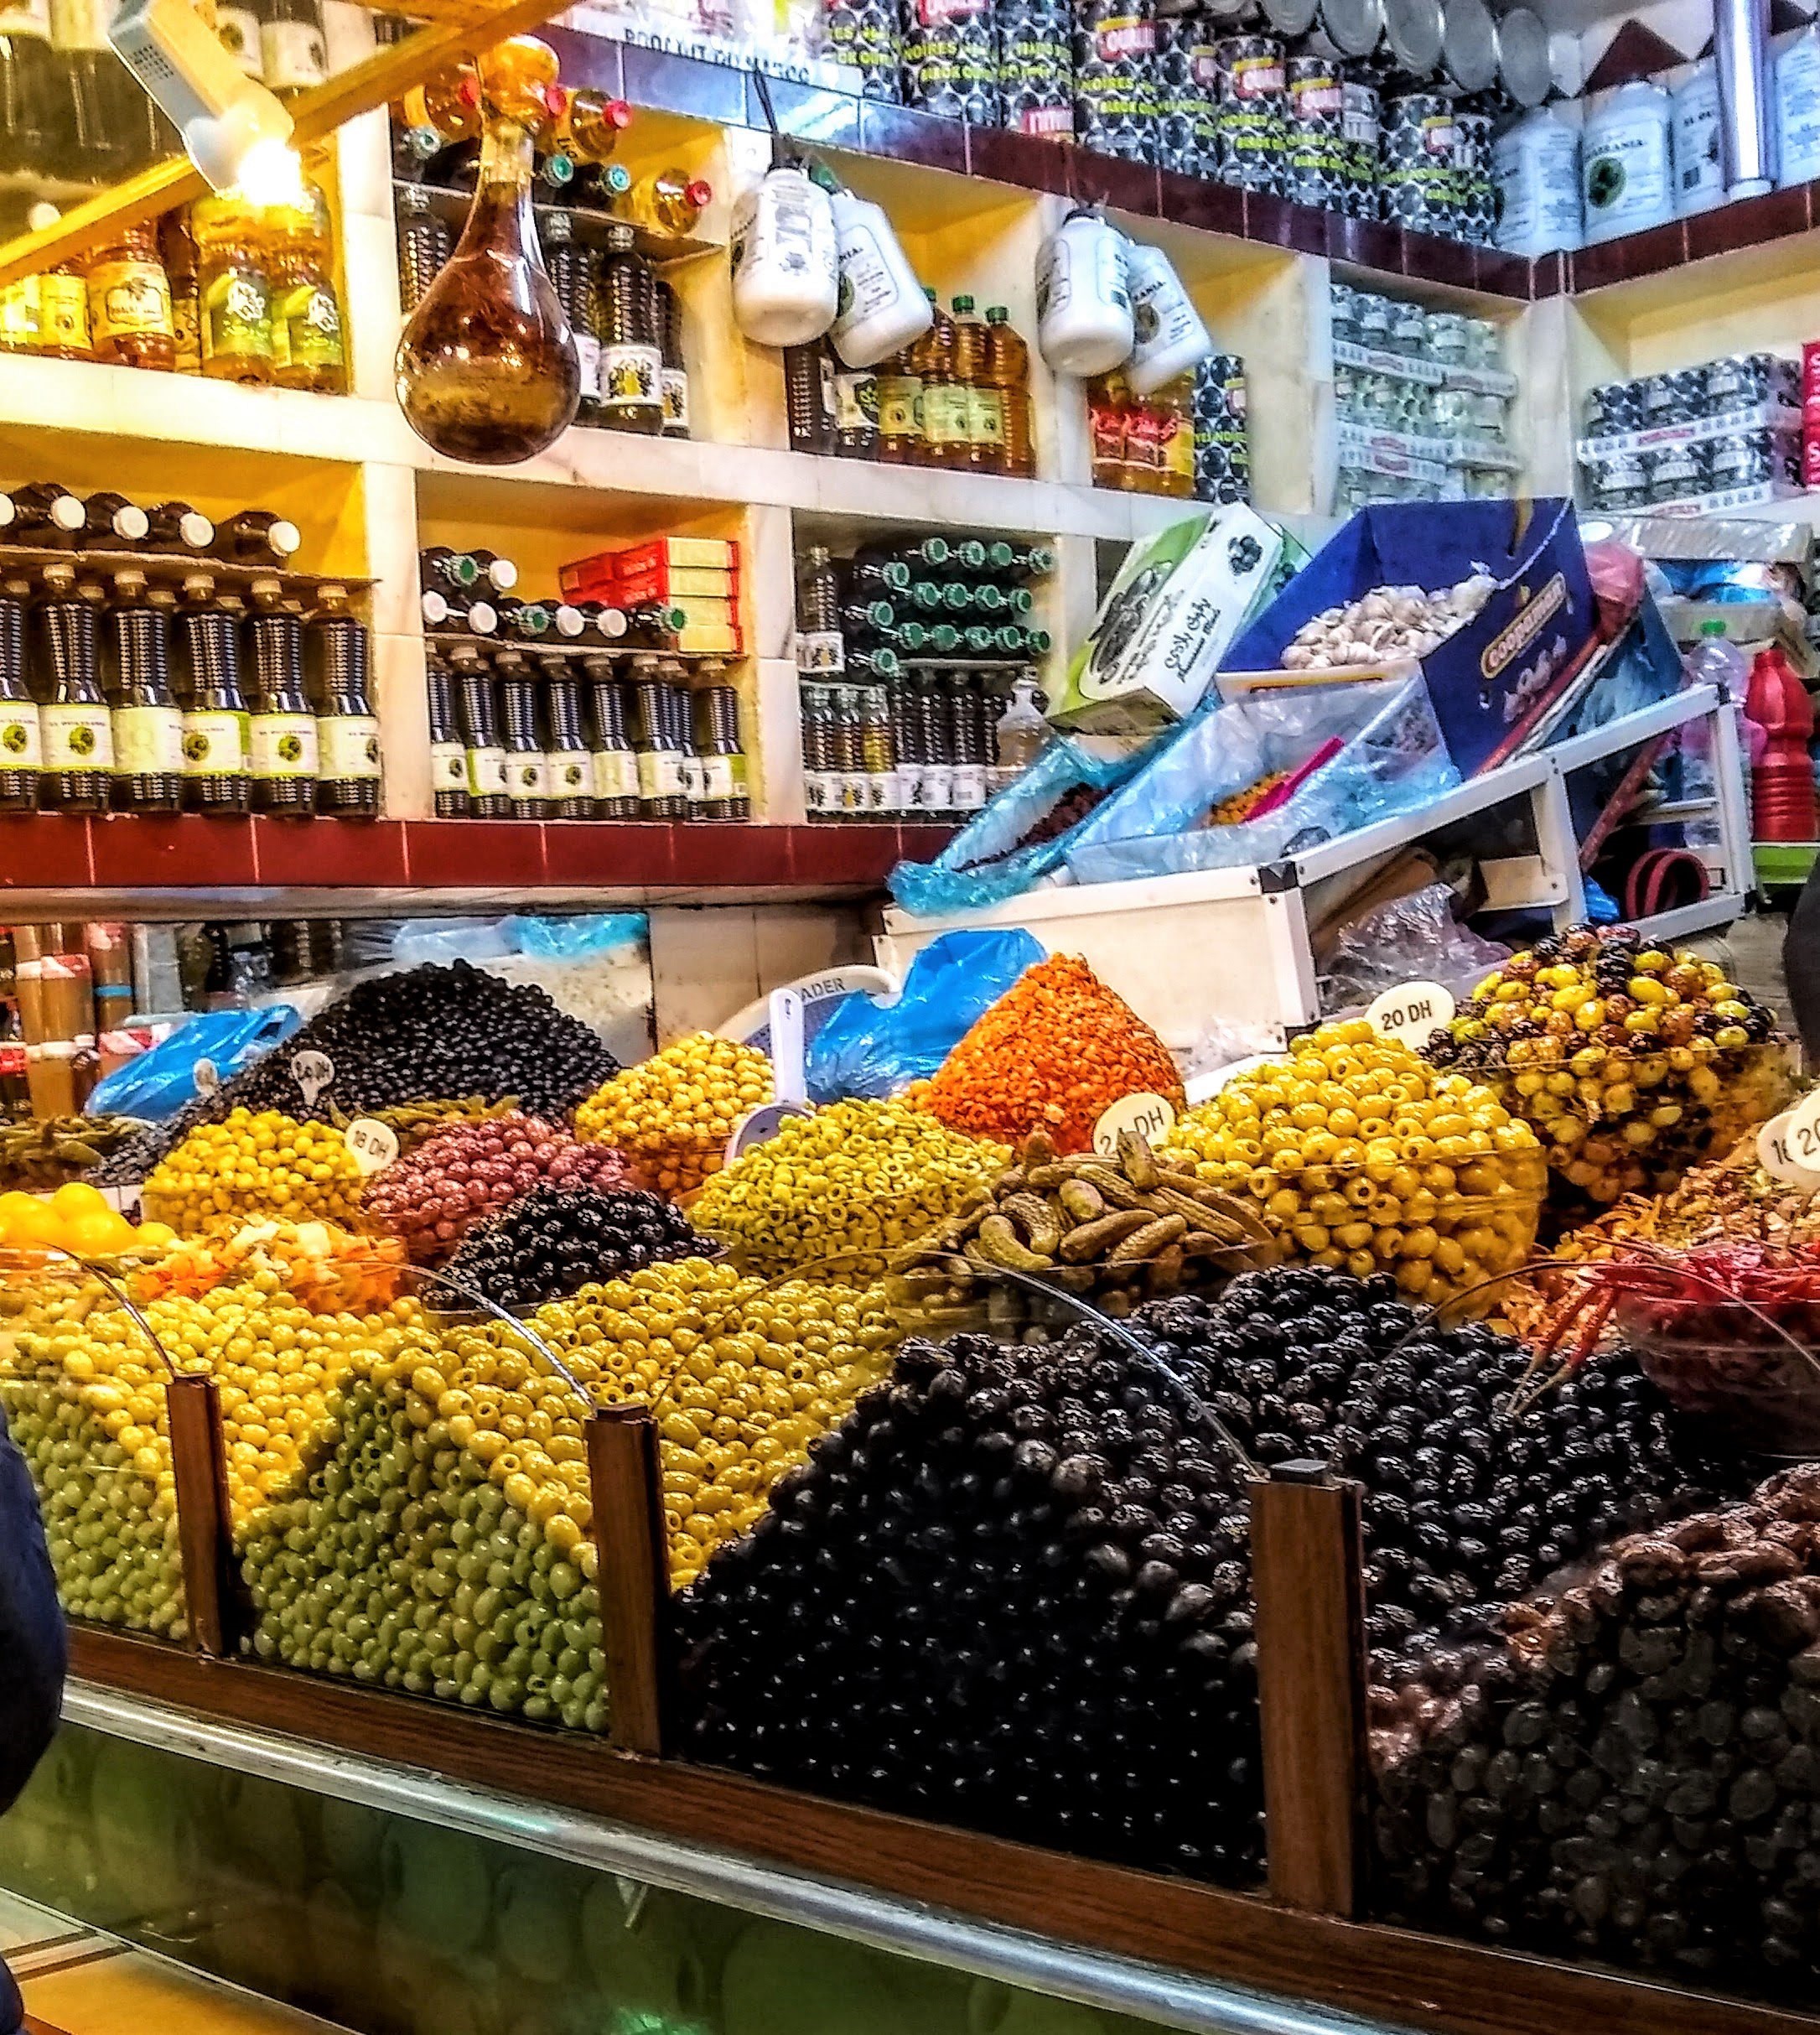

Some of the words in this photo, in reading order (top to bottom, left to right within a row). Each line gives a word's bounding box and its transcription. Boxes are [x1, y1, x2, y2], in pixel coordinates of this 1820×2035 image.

[1381, 1009, 1405, 1032] 20
[1408, 999, 1433, 1024] DH
[1134, 1106, 1164, 1137] DH
